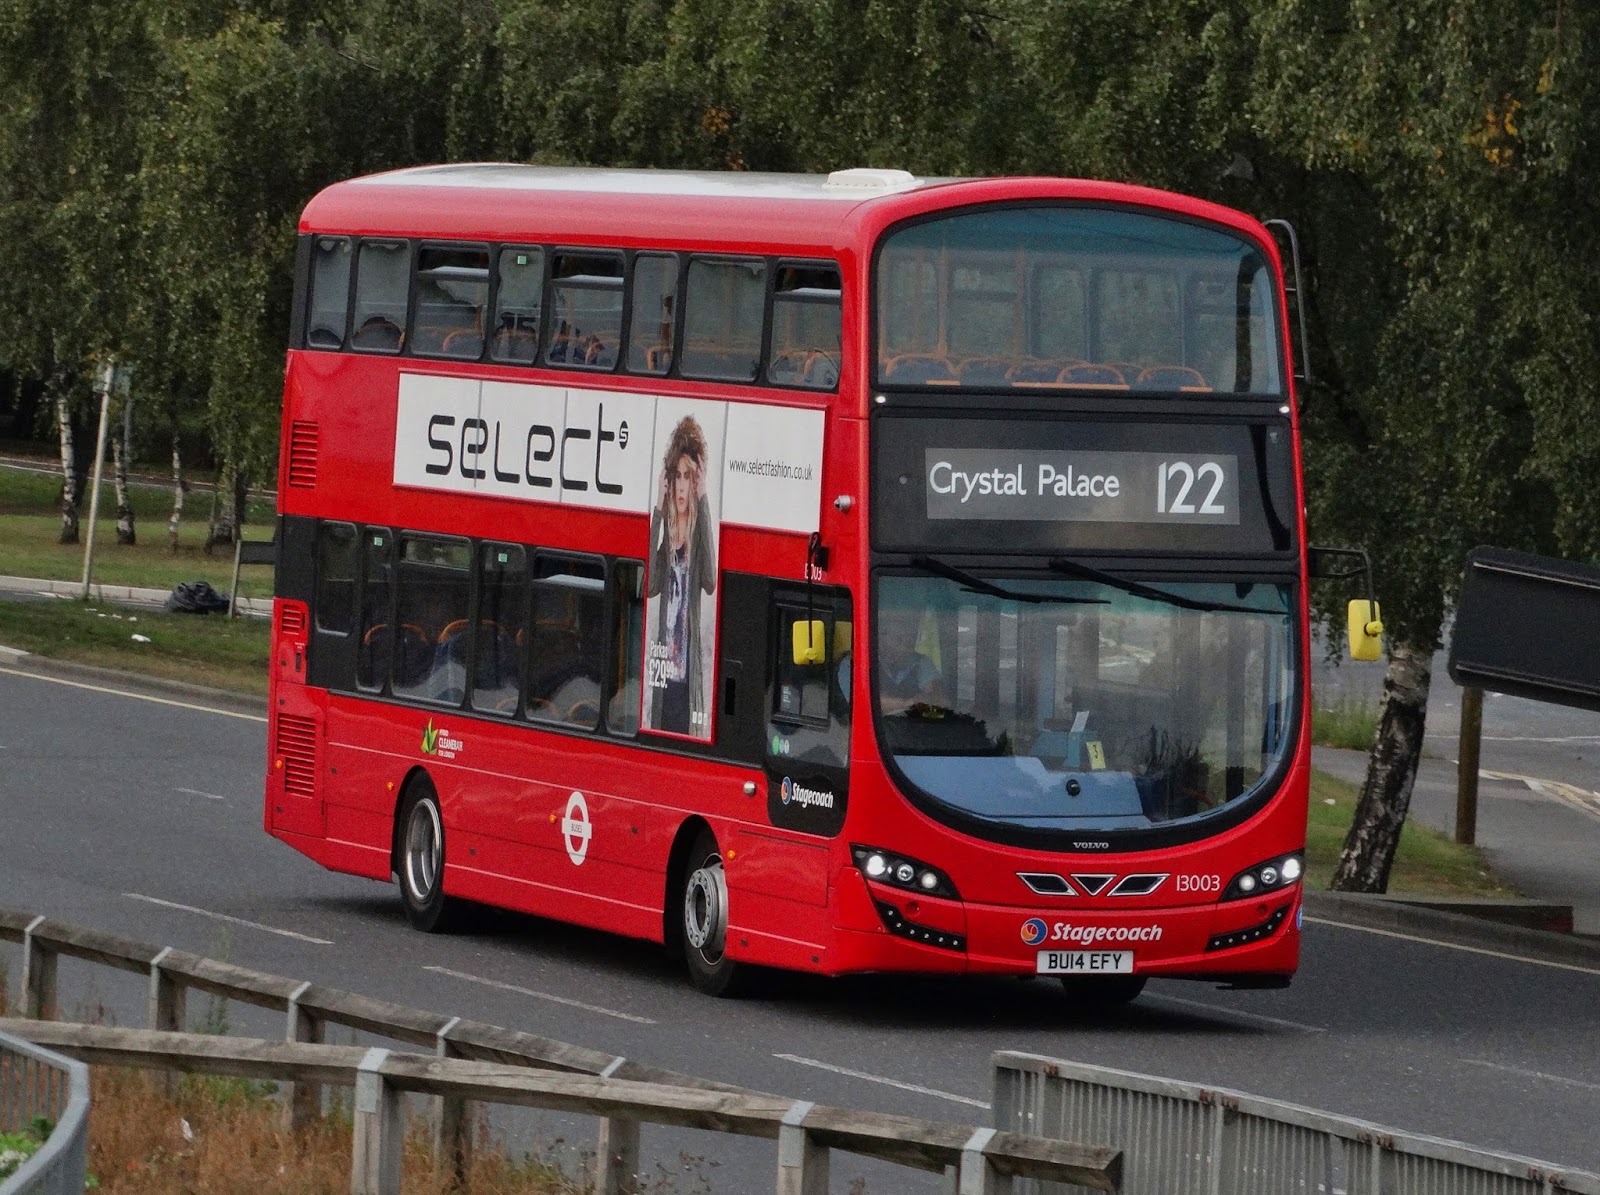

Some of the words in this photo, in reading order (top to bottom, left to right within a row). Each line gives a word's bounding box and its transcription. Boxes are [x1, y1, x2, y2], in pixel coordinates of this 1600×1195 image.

[729, 458, 813, 481] www.selectfashion.co.uk
[929, 461, 1027, 504] Crystal
[1037, 464, 1121, 498] Palace
[1157, 461, 1225, 514] 122
[791, 782, 834, 809] Stagecoach
[1072, 841, 1110, 849] VOLVO
[1176, 874, 1221, 892] 13003
[1050, 922, 1163, 946] Stagecoach
[1048, 953, 1085, 970] BU14
[1090, 953, 1122, 970] EFY
